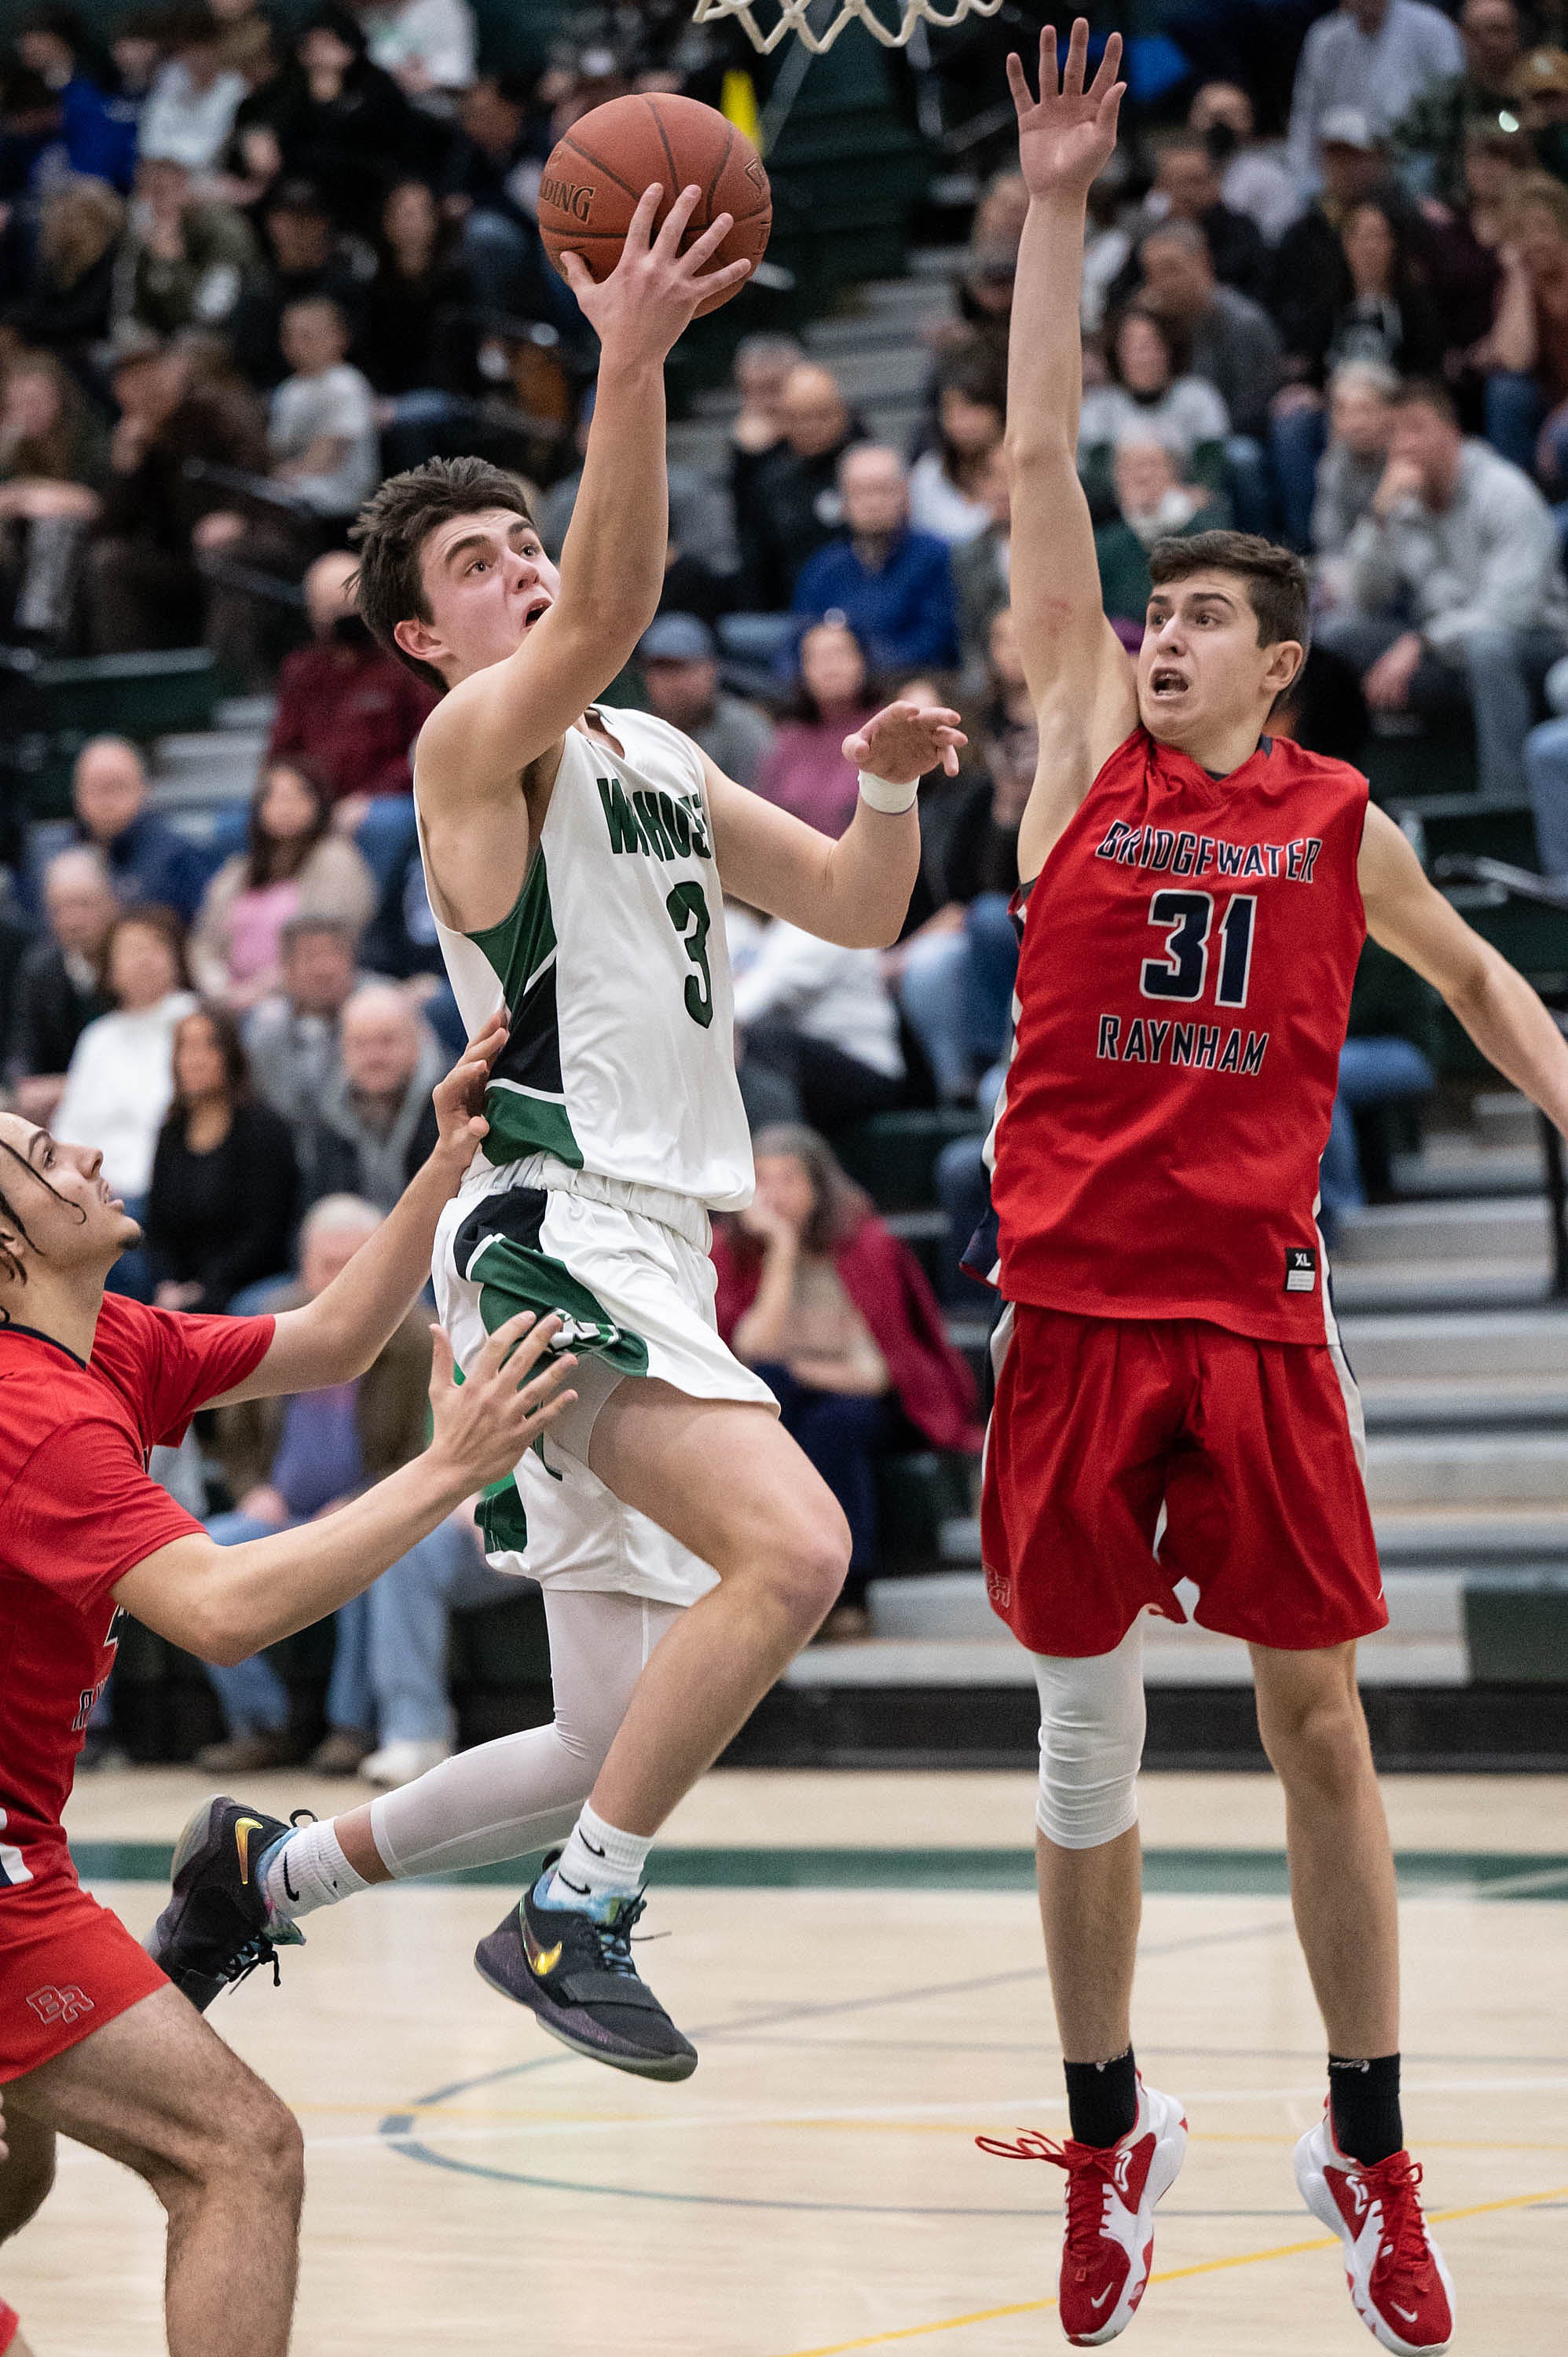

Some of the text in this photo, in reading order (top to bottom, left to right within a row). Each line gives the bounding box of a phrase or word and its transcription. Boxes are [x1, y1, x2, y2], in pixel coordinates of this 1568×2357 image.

[1096, 819, 1322, 884] BRIDGEWATER
[665, 880, 713, 1029] 3
[1139, 889, 1258, 1009] 31
[1097, 1014, 1269, 1076] RAYNHAM
[1295, 1252, 1311, 1266] XL
[26, 1985, 94, 2024] BR
